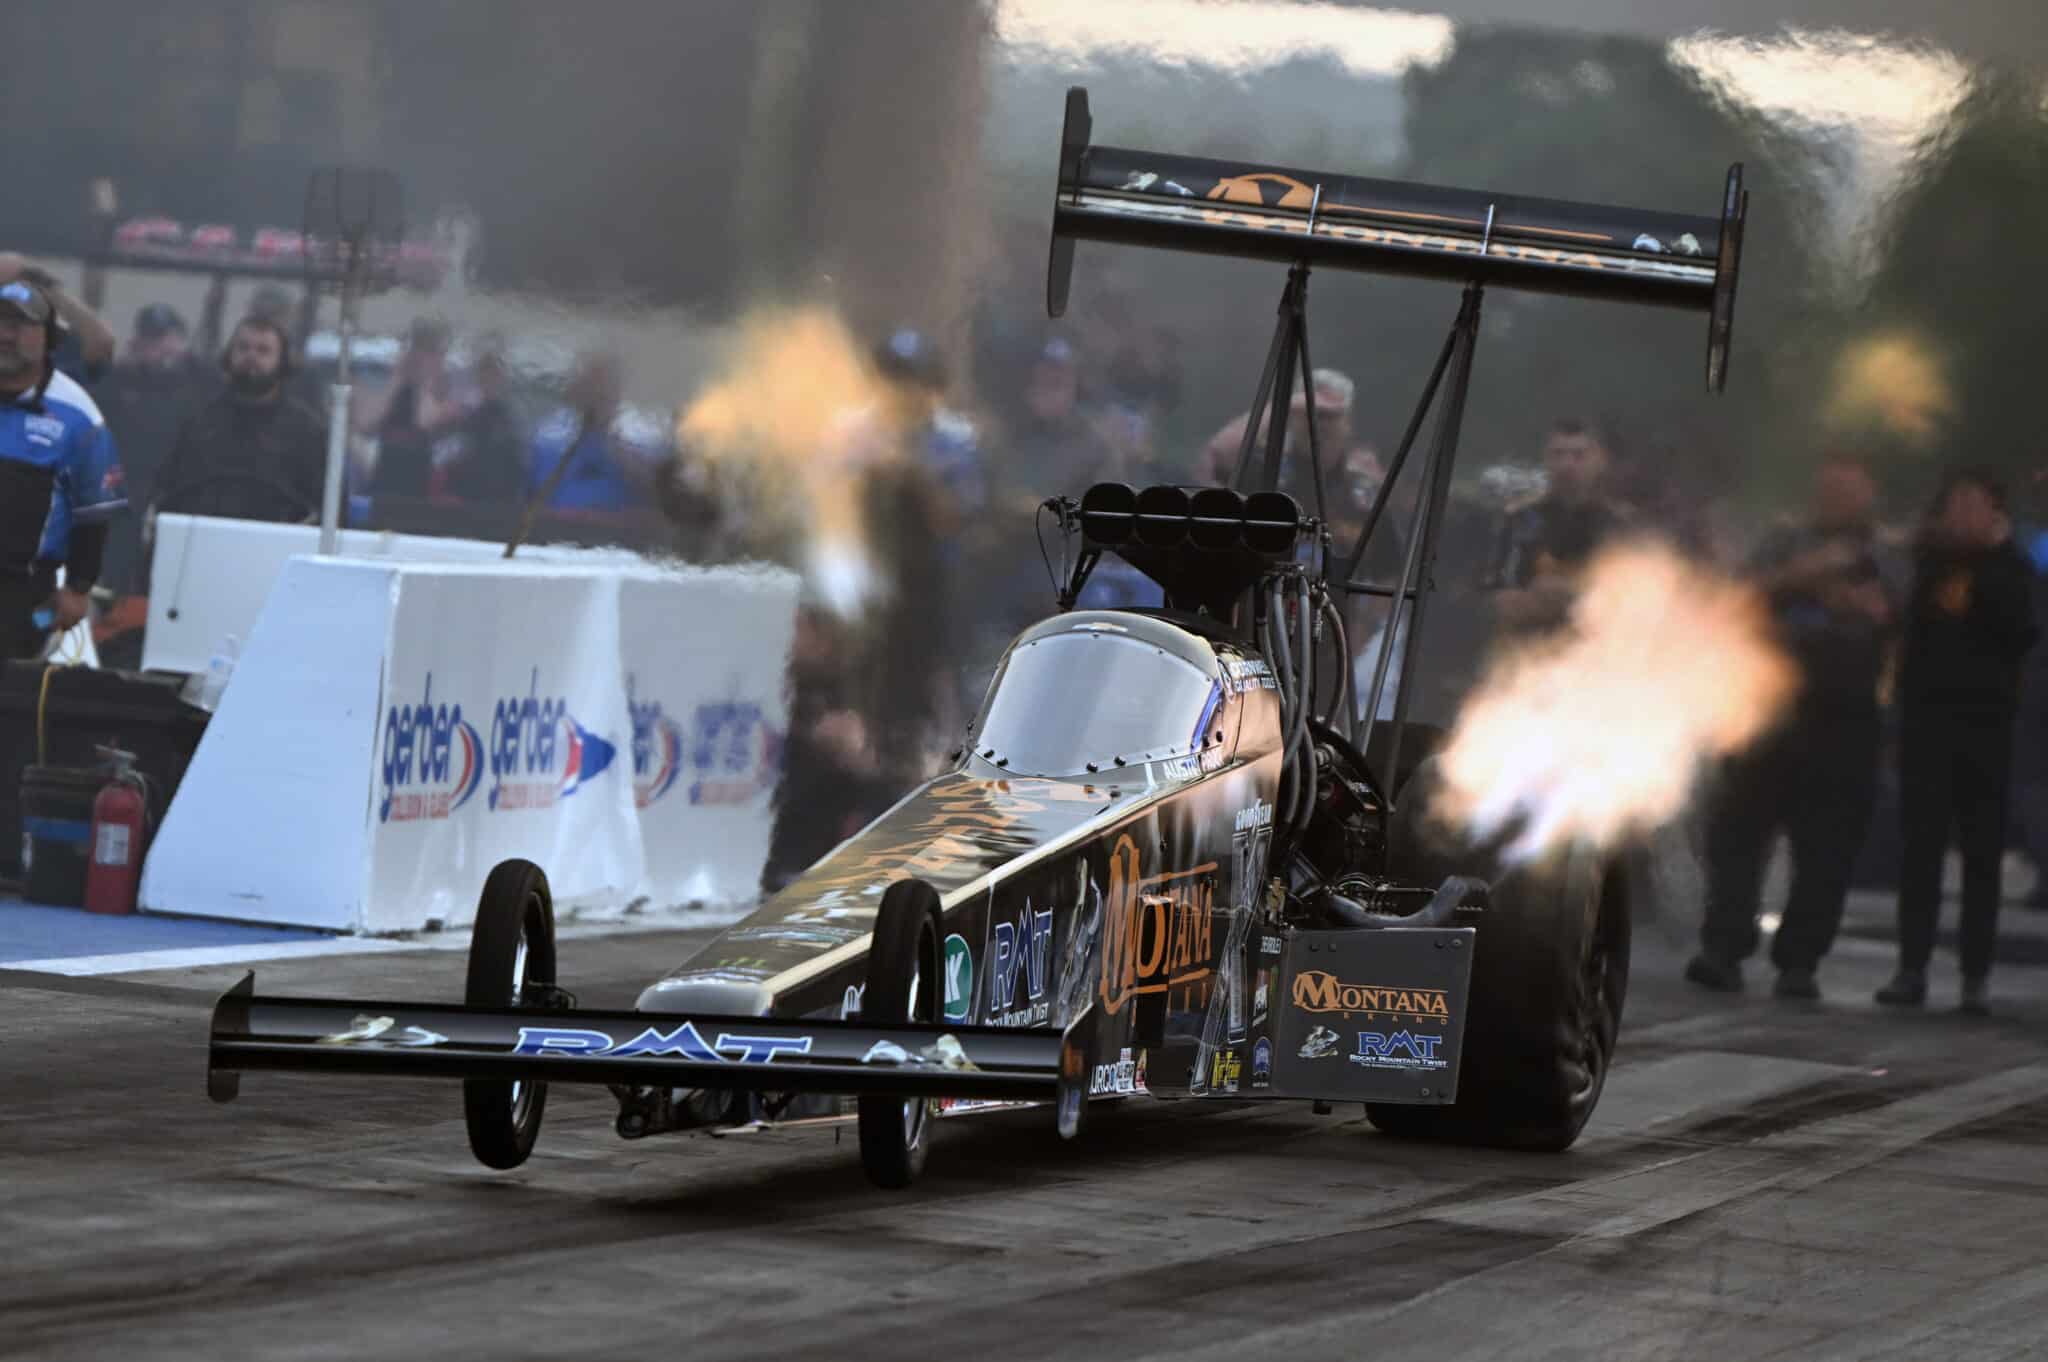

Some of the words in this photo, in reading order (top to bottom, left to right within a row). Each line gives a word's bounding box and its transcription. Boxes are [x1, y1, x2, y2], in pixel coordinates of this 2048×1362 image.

[380, 671, 462, 823] gerber
[487, 665, 566, 812] gerber
[991, 896, 1053, 1012] RMT
[1293, 971, 1449, 1014] MONTANA
[511, 1020, 812, 1064] RMT
[1349, 1053, 1377, 1063] ROCKY
[1378, 1055, 1421, 1065] MOUNTAIN
[1422, 1058, 1449, 1067] TWIST
[1357, 1028, 1442, 1059] RMT
